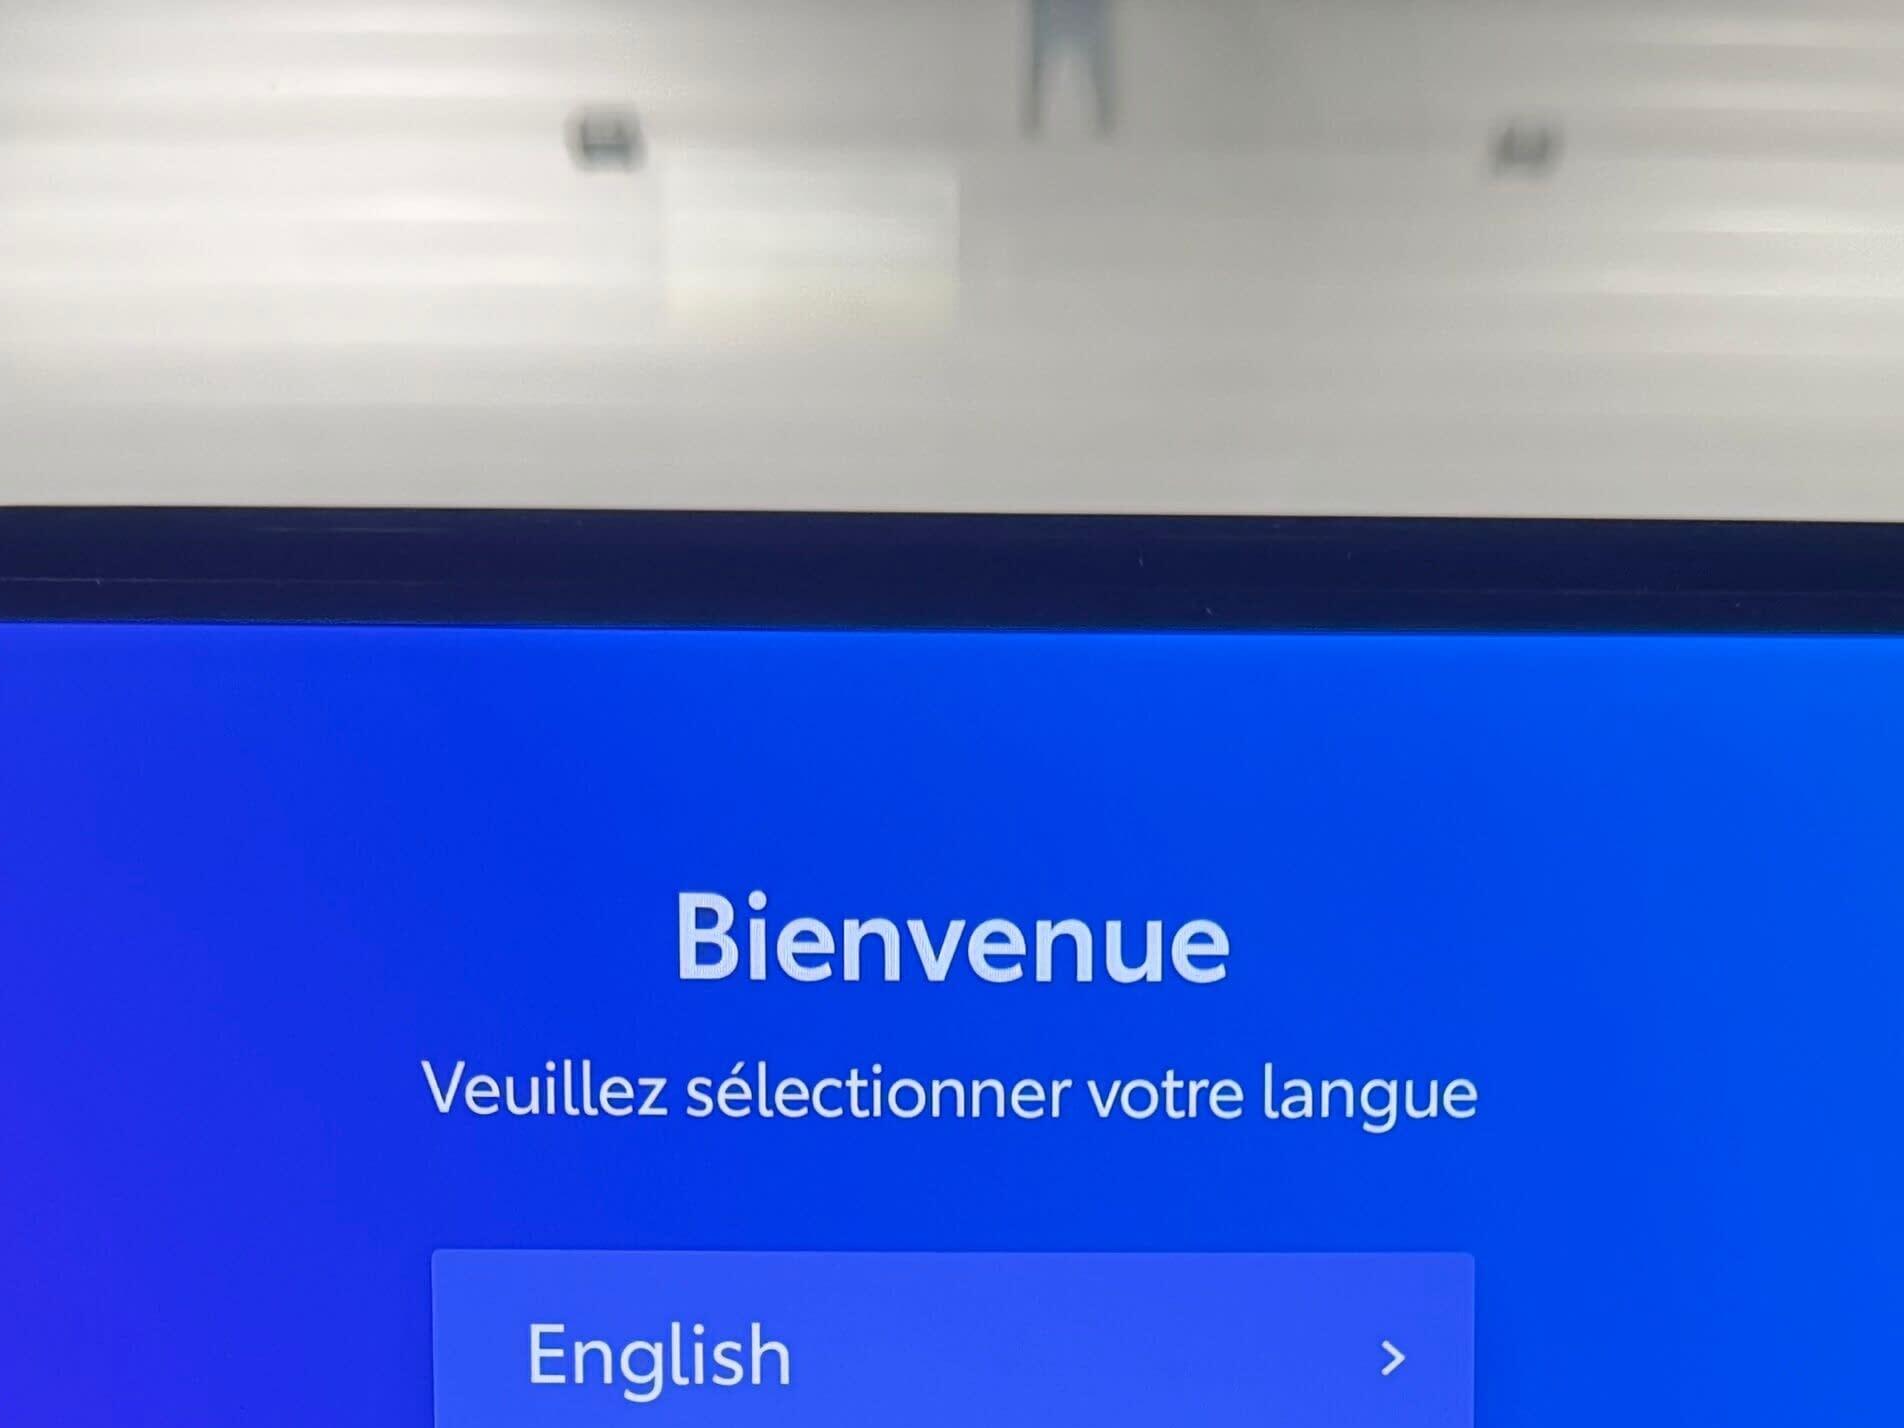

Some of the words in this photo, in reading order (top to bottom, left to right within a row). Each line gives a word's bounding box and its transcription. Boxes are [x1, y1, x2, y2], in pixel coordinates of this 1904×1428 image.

[676, 890, 1232, 985] Bienvenue
[420, 1058, 670, 1118] Veuillez
[682, 1055, 1073, 1125] sélectionner
[1088, 1060, 1246, 1125] votre
[1260, 1060, 1482, 1138] langue
[527, 1321, 793, 1404] English
